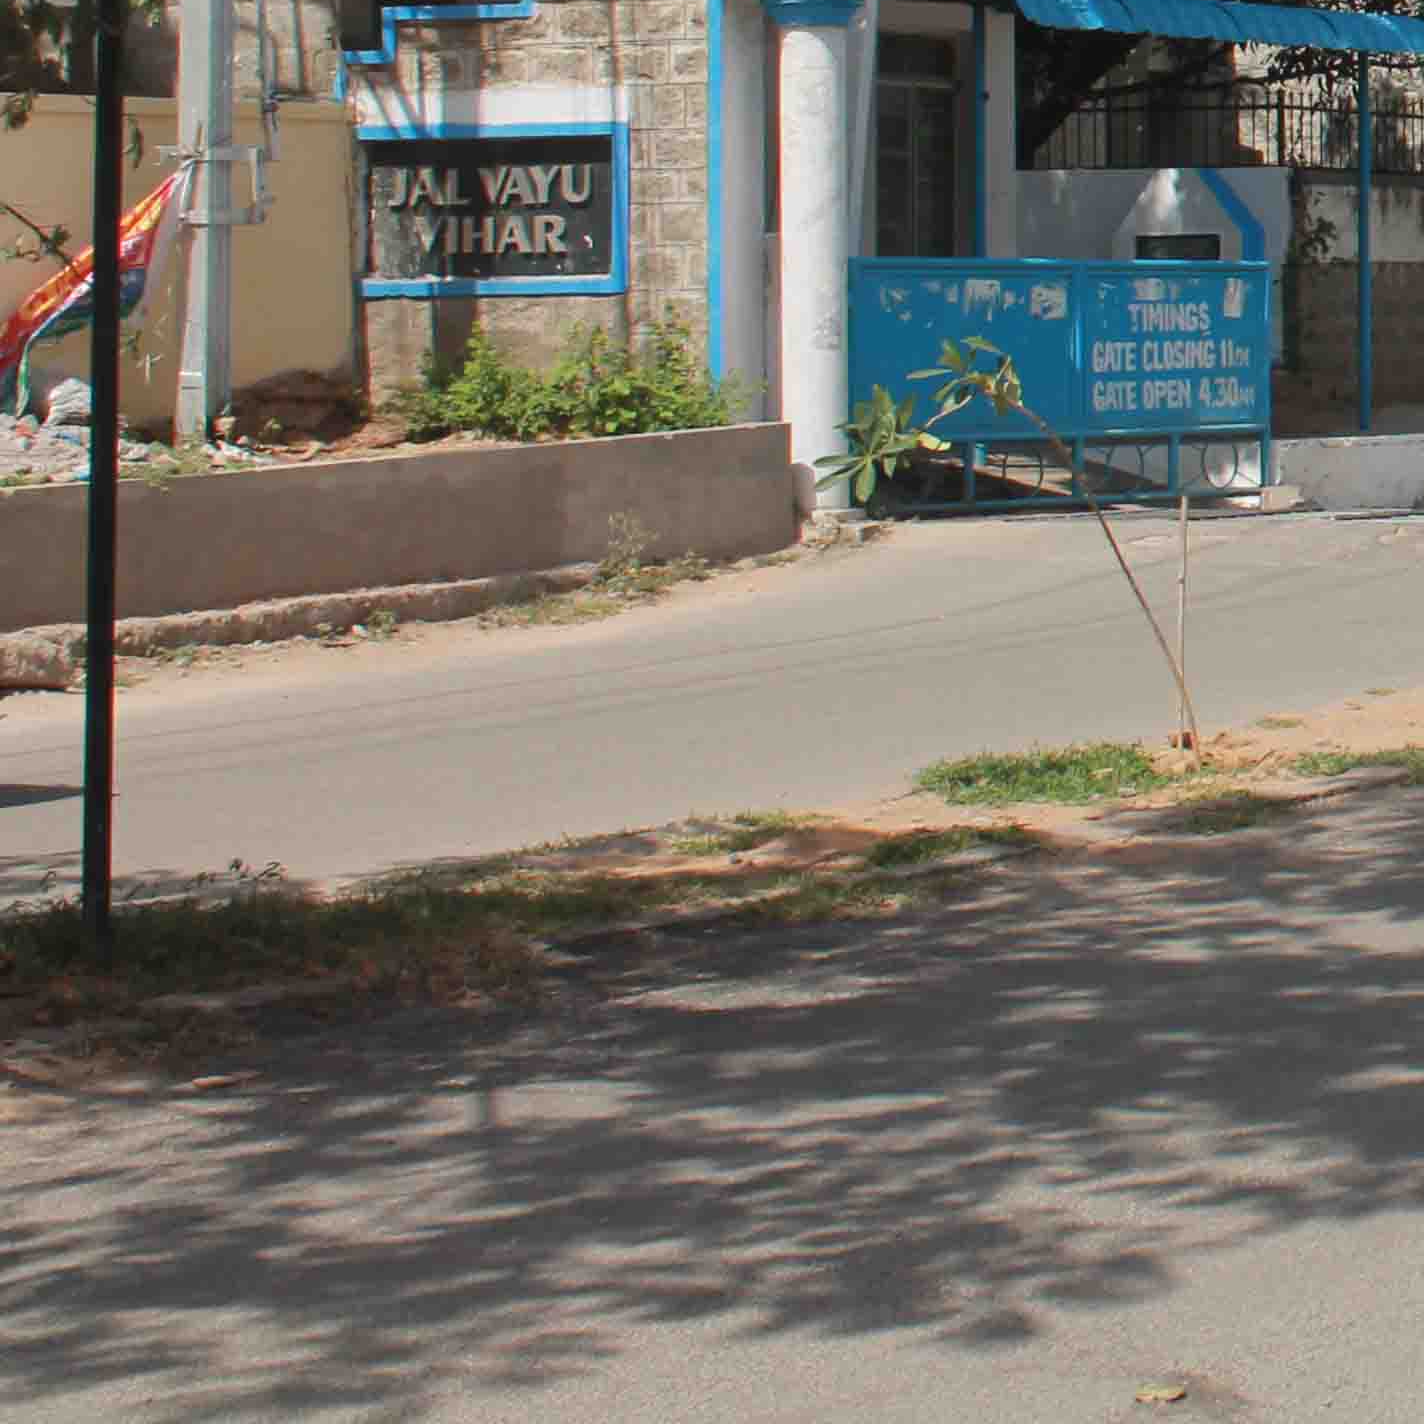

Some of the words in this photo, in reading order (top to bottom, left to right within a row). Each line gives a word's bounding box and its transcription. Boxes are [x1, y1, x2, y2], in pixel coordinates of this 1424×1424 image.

[387, 165, 469, 207] JAL
[478, 163, 594, 206] VAYU
[413, 214, 568, 254] VIHAR
[1128, 301, 1212, 334] TIMINGS
[1093, 340, 1137, 372] GATE
[1143, 338, 1216, 372] CLOSING
[1093, 379, 1137, 411] GATE
[1143, 378, 1192, 409] OPEN
